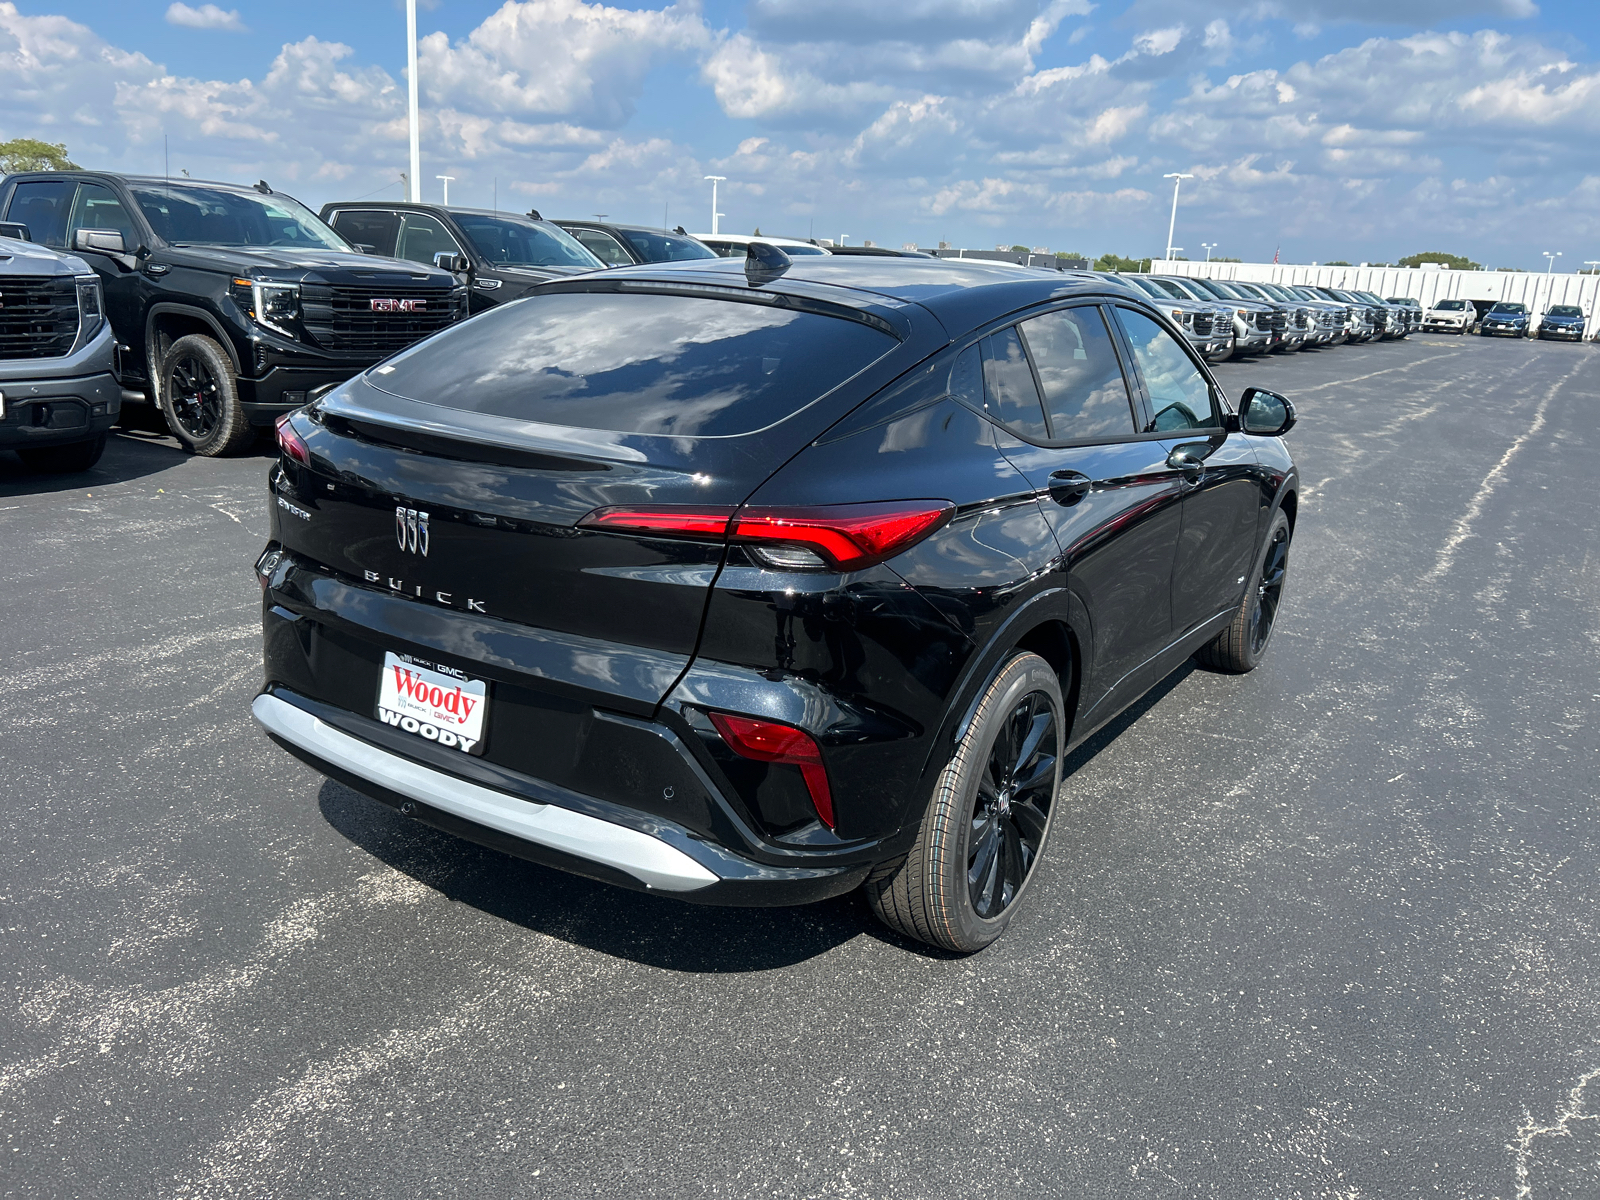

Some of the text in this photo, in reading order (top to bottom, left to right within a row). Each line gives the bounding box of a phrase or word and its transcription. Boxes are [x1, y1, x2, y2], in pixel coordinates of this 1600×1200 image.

[370, 299, 427, 313] GMC
[364, 569, 487, 613] BUICK
[437, 664, 464, 679] GMC
[392, 664, 478, 724] Woody
[407, 703, 455, 724] BUICK GMC
[378, 707, 477, 753] WOODY
